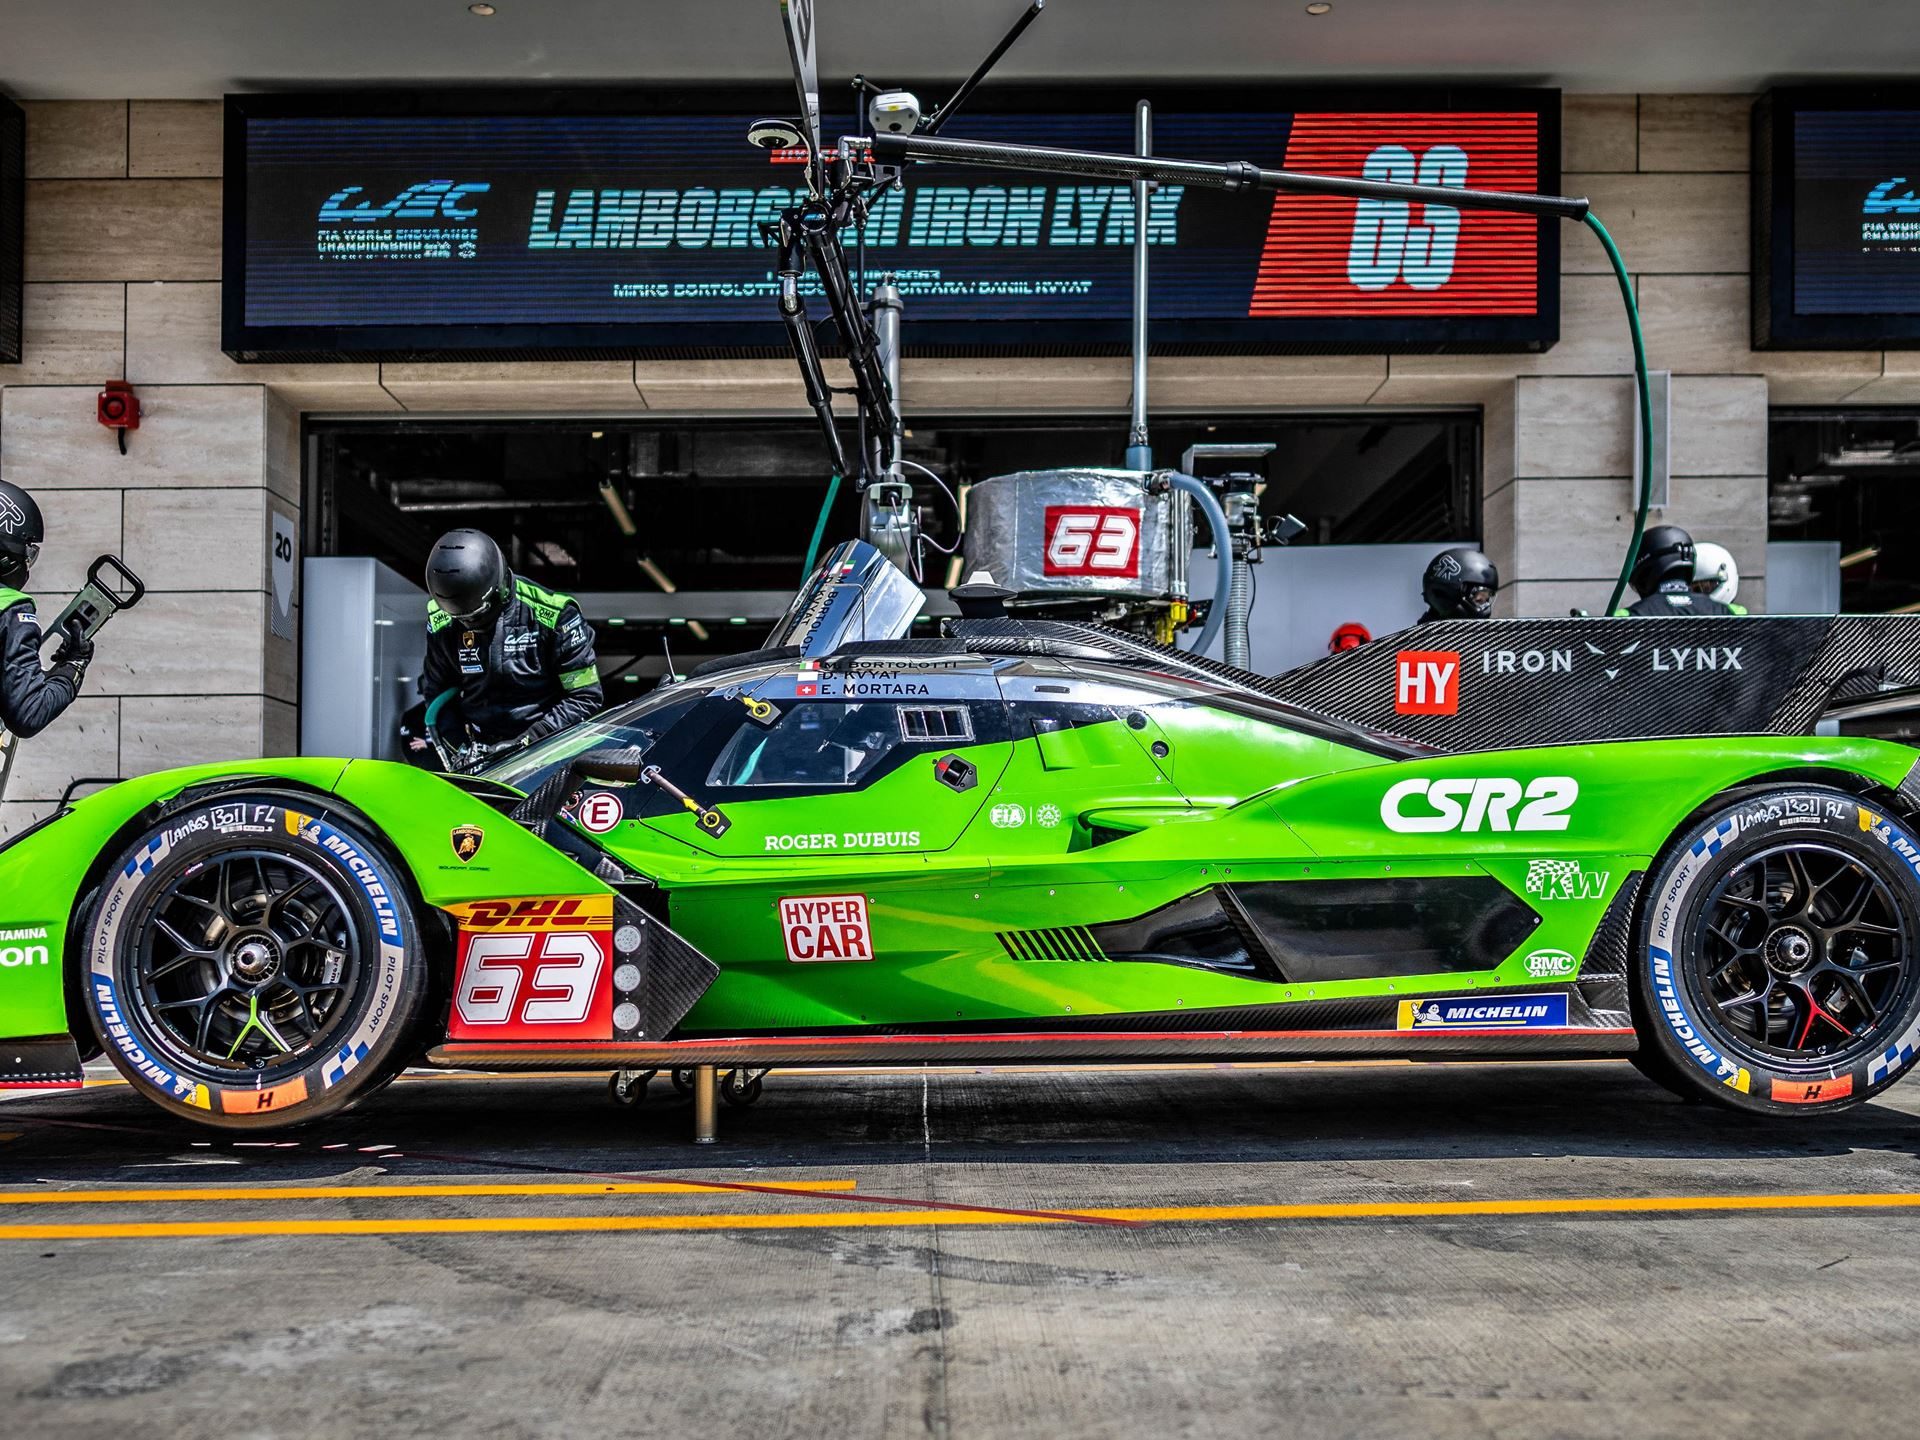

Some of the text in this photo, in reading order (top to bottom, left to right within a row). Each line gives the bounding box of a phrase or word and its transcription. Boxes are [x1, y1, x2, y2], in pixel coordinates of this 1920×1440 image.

[318, 179, 491, 222] WEC
[908, 185, 1047, 247] IRON
[1049, 185, 1185, 246] LYNX
[1346, 144, 1470, 291] 63
[275, 531, 292, 563] 20
[1048, 514, 1136, 569] 63
[844, 670, 901, 681] KVYAT
[849, 661, 958, 670] BORTOLOTTI
[1482, 647, 1743, 674] IRON LYNX
[821, 683, 930, 695] E. MORTARA
[1398, 662, 1456, 705] HY
[254, 805, 276, 824] FL
[590, 802, 610, 824] E
[991, 809, 1023, 823] FIA
[1380, 776, 1580, 833] CSR2
[764, 831, 921, 851] ROGER DUBUIS
[322, 834, 398, 937] MICHELIN
[1540, 871, 1610, 900] KW
[468, 899, 589, 927] DHL
[784, 900, 862, 924] HYPER
[1658, 864, 1692, 939] PILOT SPORT
[97, 887, 125, 964] PILOT SPORT
[790, 924, 867, 959] CAR
[456, 932, 604, 1025] 63
[1530, 956, 1571, 971] BMC
[368, 955, 396, 1033] PILOT SPORT
[1445, 1005, 1549, 1019] MICHELIN
[1654, 957, 1718, 1065] MICHELIN
[96, 984, 173, 1086] MICHELIN
[256, 1092, 274, 1109] H
[1803, 1085, 1822, 1099] H
